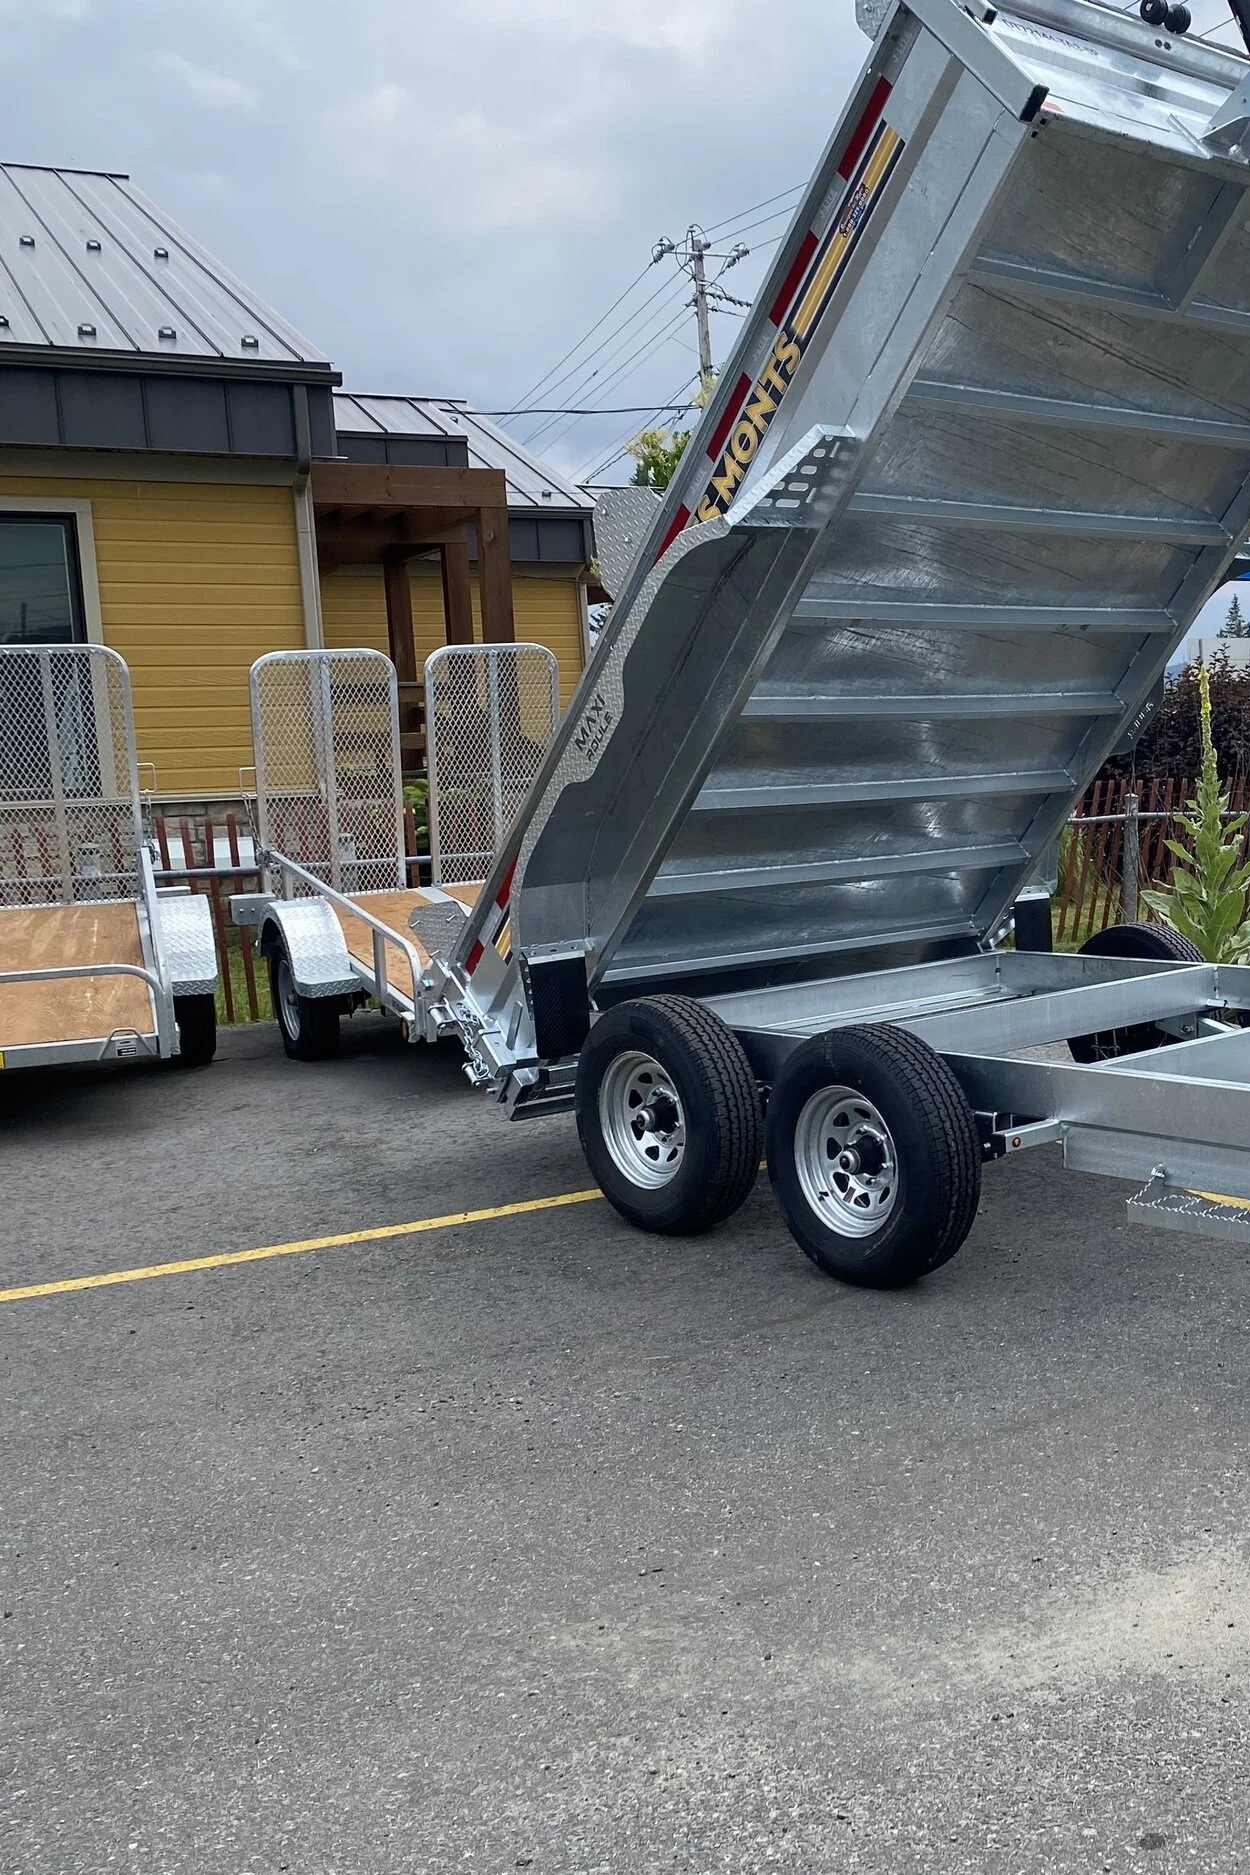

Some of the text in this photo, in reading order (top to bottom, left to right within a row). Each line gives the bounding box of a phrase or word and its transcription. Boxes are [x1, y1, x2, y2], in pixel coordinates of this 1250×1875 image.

[691, 331, 800, 527] S MONTS
[574, 694, 606, 752] MAXI
